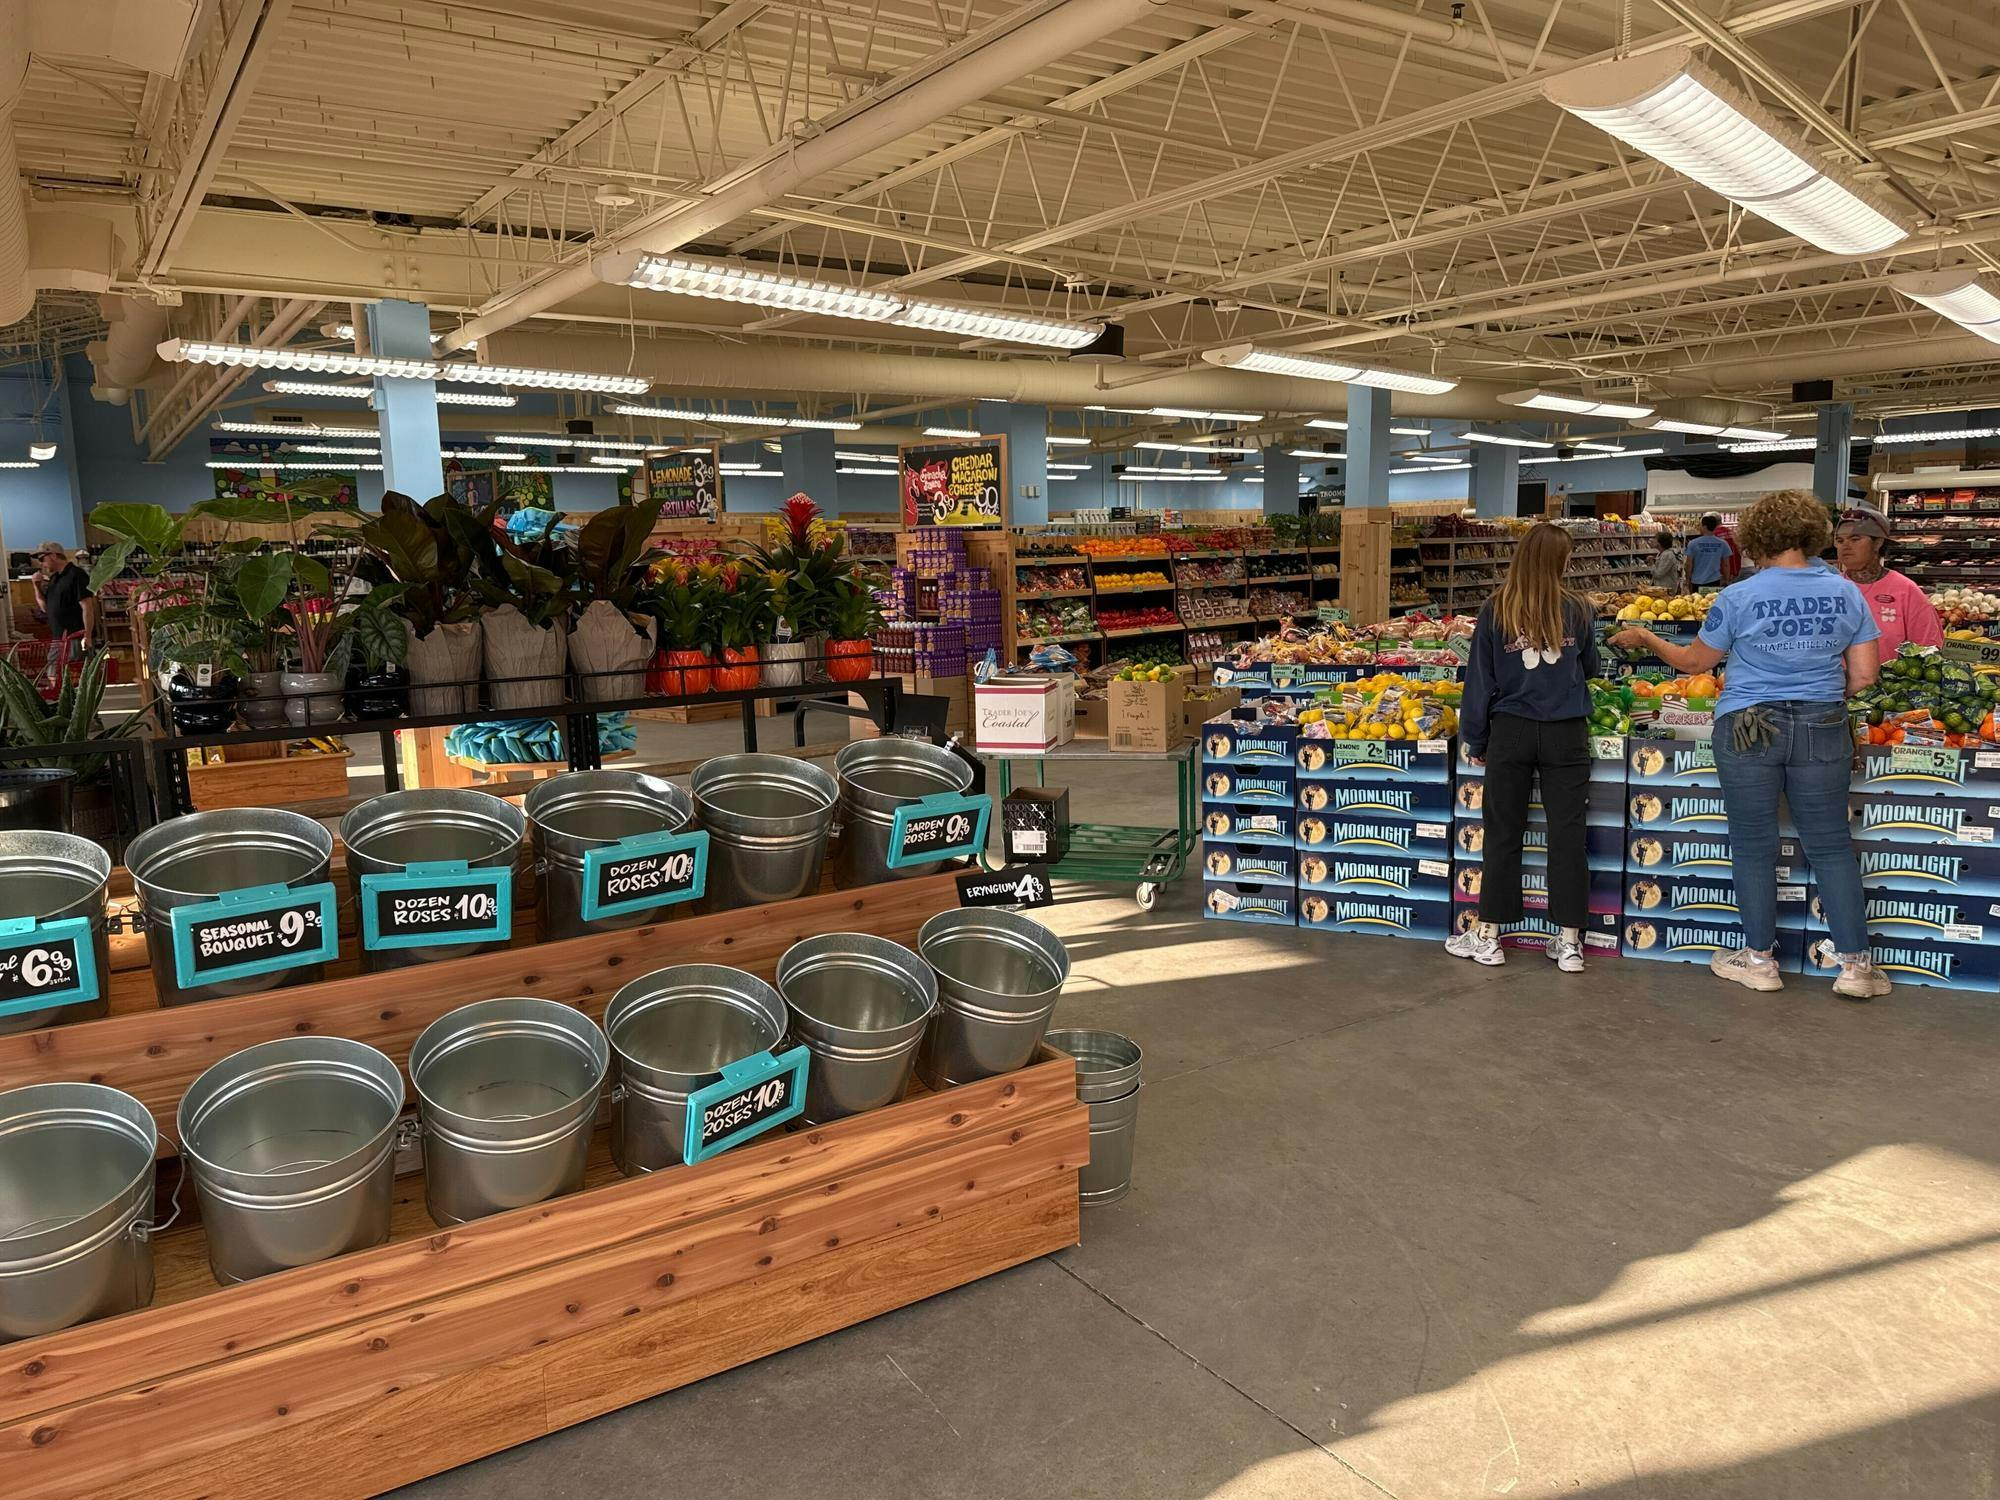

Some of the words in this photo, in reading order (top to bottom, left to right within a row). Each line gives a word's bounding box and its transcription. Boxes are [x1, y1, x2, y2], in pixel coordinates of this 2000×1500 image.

[952, 453, 993, 471] CHEDDAR
[650, 466, 693, 484] LEMONADE
[952, 468, 997, 484] MACARONI
[660, 500, 696, 515] ORTILLAS
[1752, 597, 1847, 620] TRADER
[1763, 617, 1837, 638] JOE'S
[1754, 642, 1795, 652] HAPEL
[1946, 641, 1982, 651] ORANGES
[1233, 671, 1268, 681] MOONLIGHT
[1637, 666, 1676, 679] MOONLIGHT
[982, 708, 1011, 716] TRADER
[982, 711, 1039, 728] Coastal
[1236, 739, 1288, 756] MOONLIGHT
[1894, 747, 1932, 756] ORANGES
[1235, 778, 1287, 796] MOONLIGHT
[1335, 788, 1412, 812] MOONLIGHT
[1671, 797, 1727, 820] MOONL
[905, 819, 944, 834] GARDEN
[1863, 803, 1966, 832] MOONLIGHT
[903, 830, 937, 845] ROSES
[1334, 822, 1411, 849] MOONLIGHT
[610, 859, 657, 877] DOZEN
[1236, 858, 1288, 876] MOONLIGHT
[1860, 851, 1962, 881] MOONLIGHT
[607, 871, 661, 897] ROSES
[1335, 862, 1411, 889] MOONLIGHT
[966, 881, 1018, 898] ERYNGIUM
[1671, 886, 1737, 907] MOONLI
[395, 896, 450, 910] DOZEN
[1237, 896, 1288, 914] MOONLIGHT
[1865, 899, 1958, 925] MOONLIGHT
[393, 908, 451, 925] ROSES
[1336, 901, 1413, 928] MOONLIGHT
[200, 919, 272, 942] SEASONAL
[1666, 926, 1746, 950] MOONLIGH
[200, 931, 274, 957] BOUQUET
[1516, 938, 1546, 946] ORGAN
[1869, 946, 1955, 978] OONLIGHT
[704, 1090, 753, 1124] DOZEN
